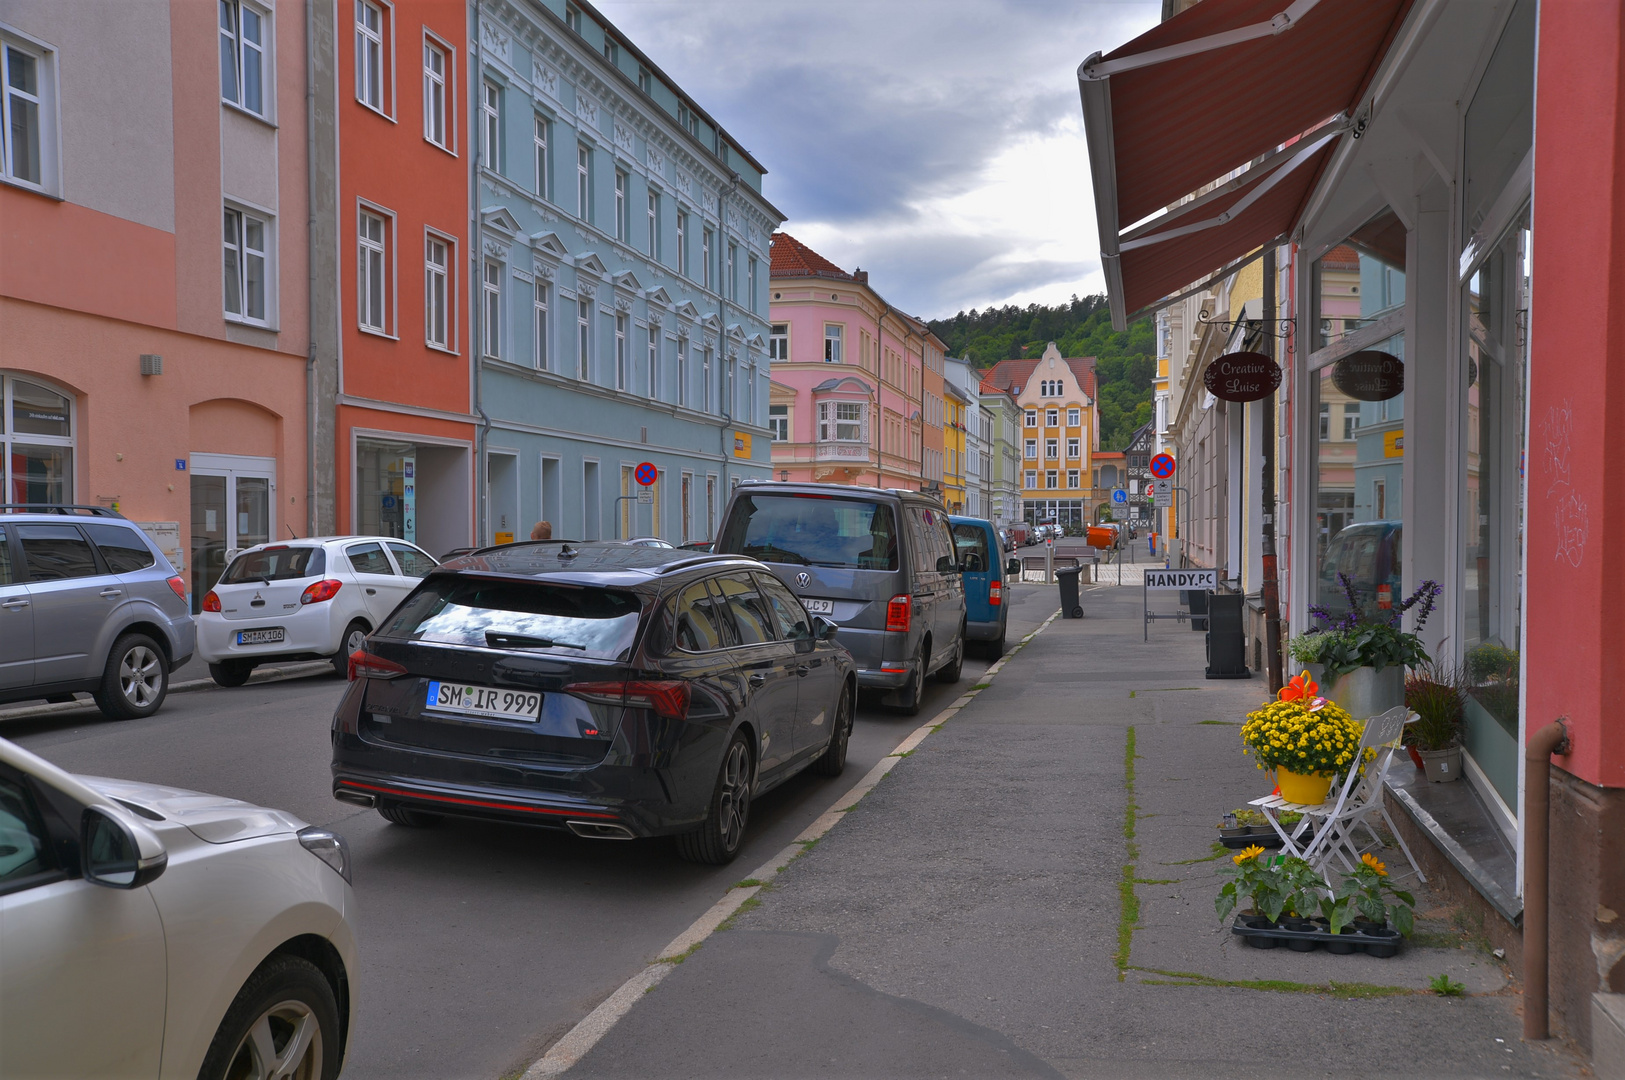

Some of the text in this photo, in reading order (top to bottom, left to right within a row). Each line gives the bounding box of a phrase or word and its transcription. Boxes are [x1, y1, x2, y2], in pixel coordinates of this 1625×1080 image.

[1221, 362, 1265, 375] Creative
[1225, 378, 1260, 393] Luise
[821, 601, 829, 612] 9
[267, 630, 283, 640] 106
[438, 685, 539, 715] SM IR 999
